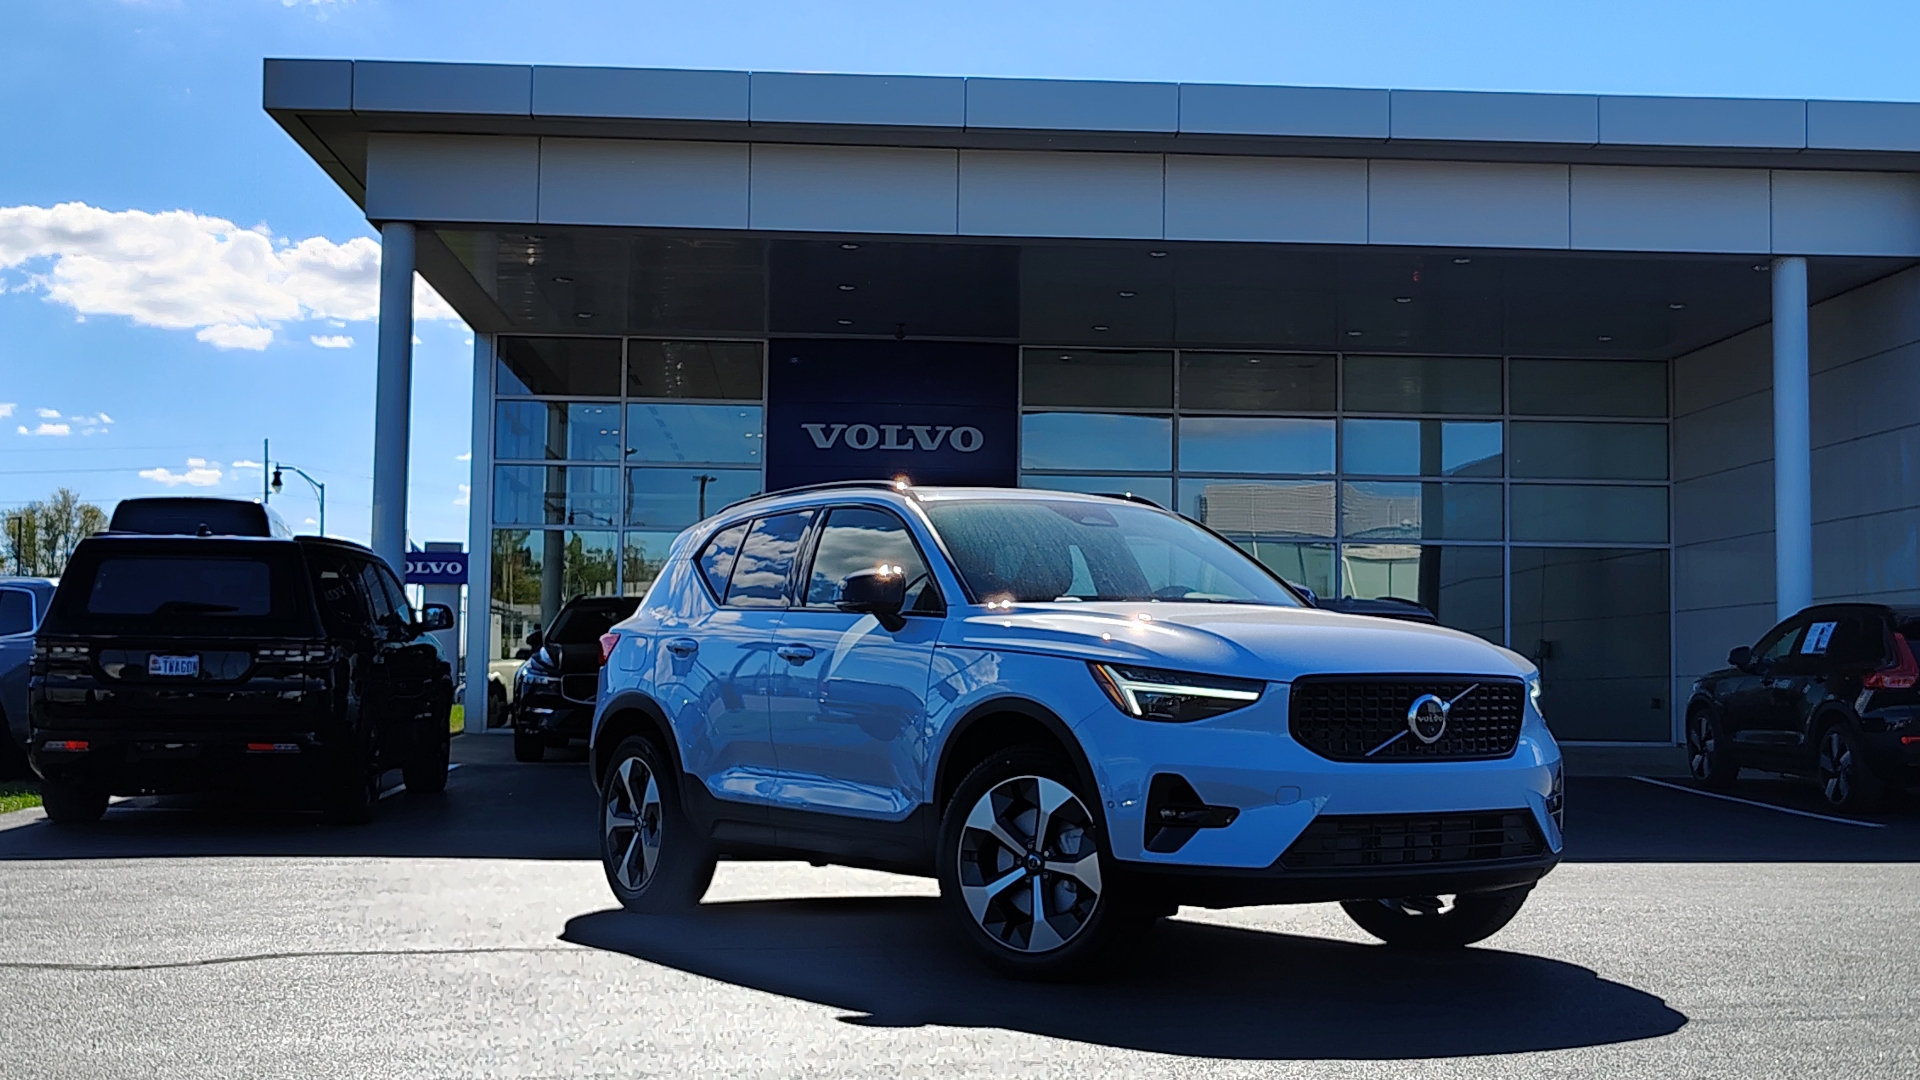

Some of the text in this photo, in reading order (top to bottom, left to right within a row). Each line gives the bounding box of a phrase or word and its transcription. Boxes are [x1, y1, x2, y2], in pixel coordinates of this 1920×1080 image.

[801, 424, 984, 452] VOLVO
[405, 561, 463, 575] OLVO
[1417, 713, 1443, 723] VOLVO
